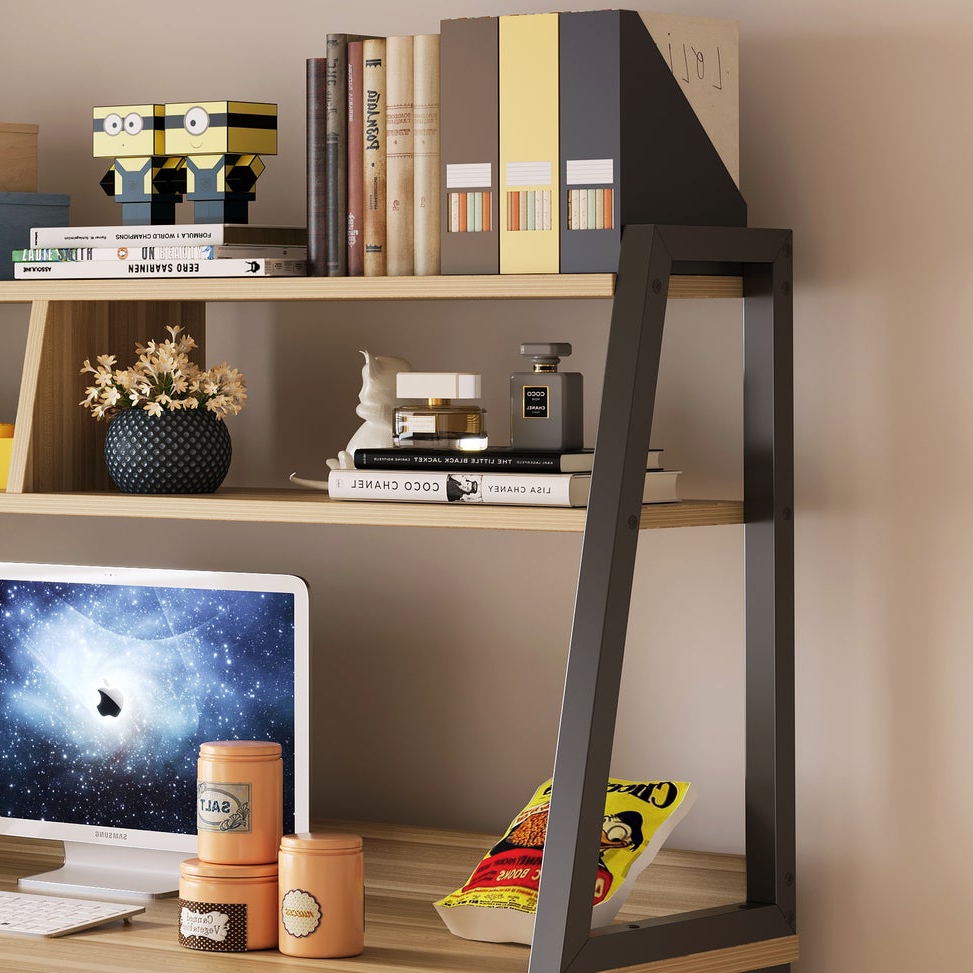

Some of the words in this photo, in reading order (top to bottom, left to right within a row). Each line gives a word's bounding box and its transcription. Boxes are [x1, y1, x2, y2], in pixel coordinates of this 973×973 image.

[152, 232, 176, 240] WORLD
[182, 231, 212, 239] FORMULA
[21, 248, 53, 261] ZADIE
[141, 247, 155, 260] ON
[128, 263, 173, 274] SAARINEN
[176, 263, 200, 273] EERO
